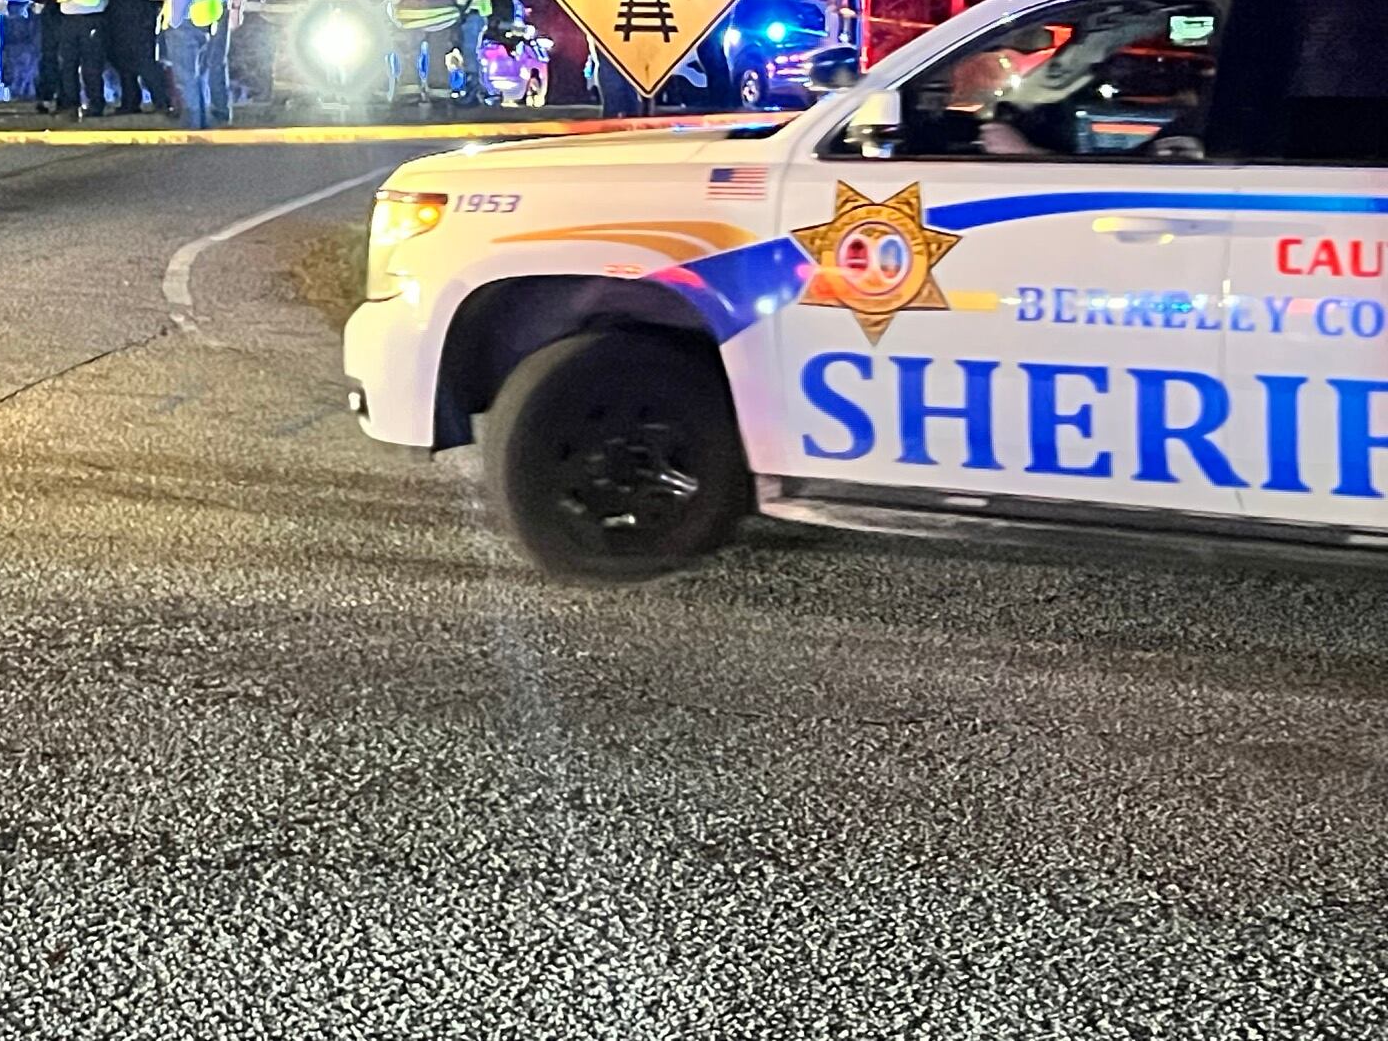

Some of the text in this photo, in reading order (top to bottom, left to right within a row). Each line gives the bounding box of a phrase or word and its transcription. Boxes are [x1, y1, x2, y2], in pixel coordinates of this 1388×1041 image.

[453, 193, 521, 213] 1953
[1277, 238, 1388, 277] CAU
[1015, 286, 1293, 333] BERKELEY
[799, 351, 1388, 499] SHERIF
